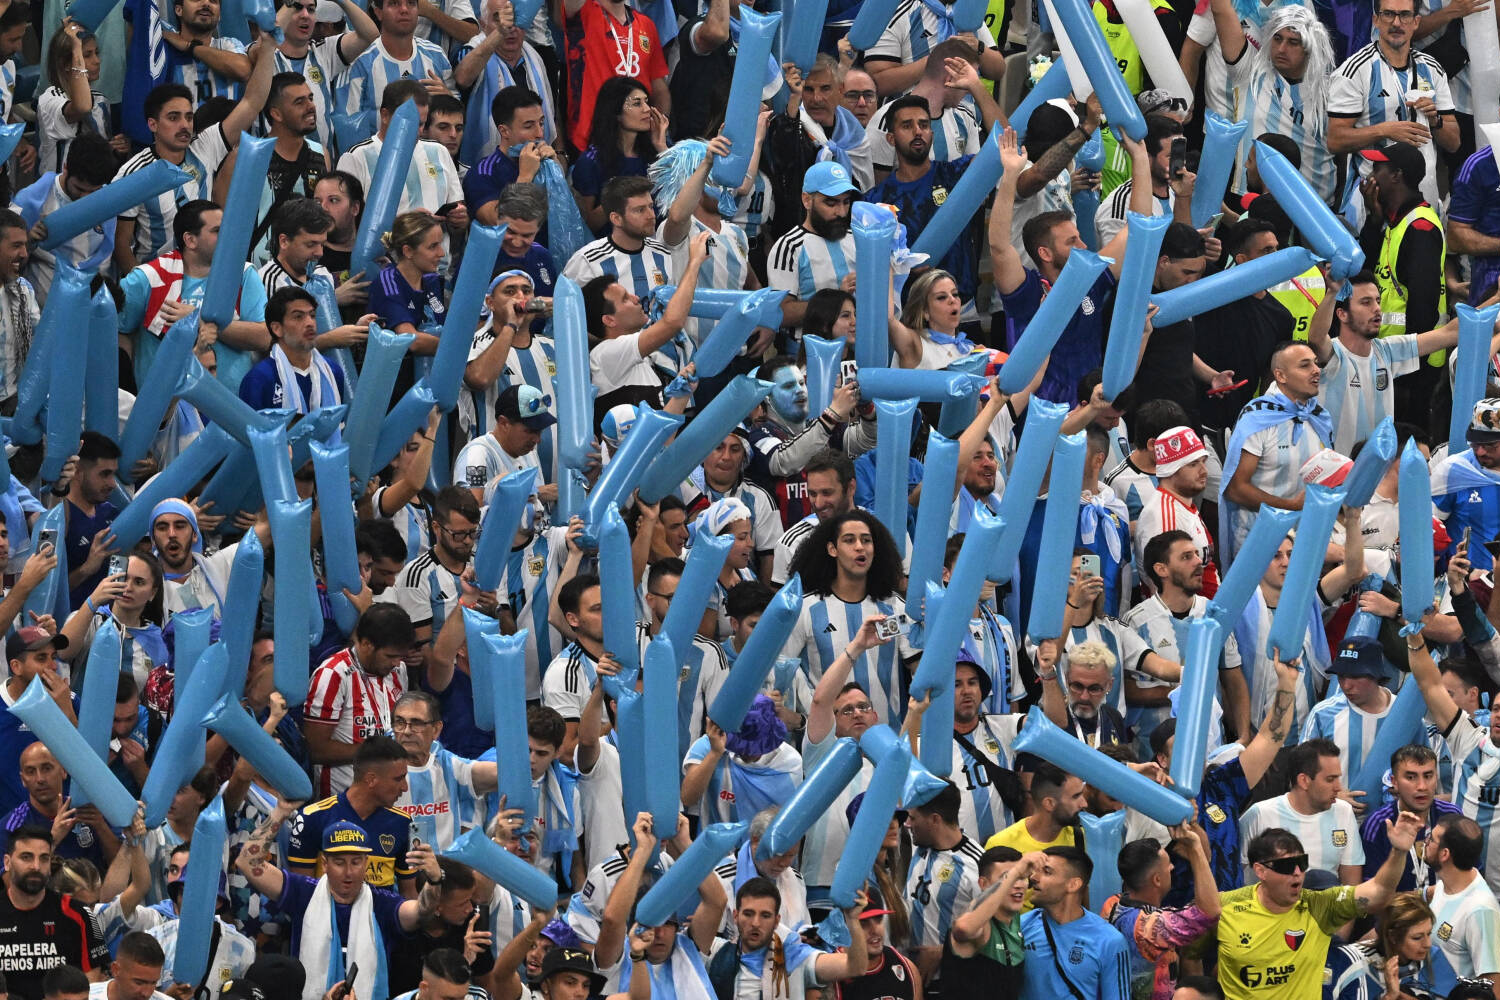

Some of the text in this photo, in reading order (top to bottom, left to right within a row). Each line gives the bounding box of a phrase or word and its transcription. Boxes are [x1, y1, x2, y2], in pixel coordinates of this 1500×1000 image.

[786, 482, 809, 500] MA
[961, 762, 991, 791] 10
[330, 834, 365, 844] LIBERTY
[0, 942, 57, 958] PAPELERA
[1266, 964, 1296, 976] PLUS
[1265, 974, 1290, 986] ART
